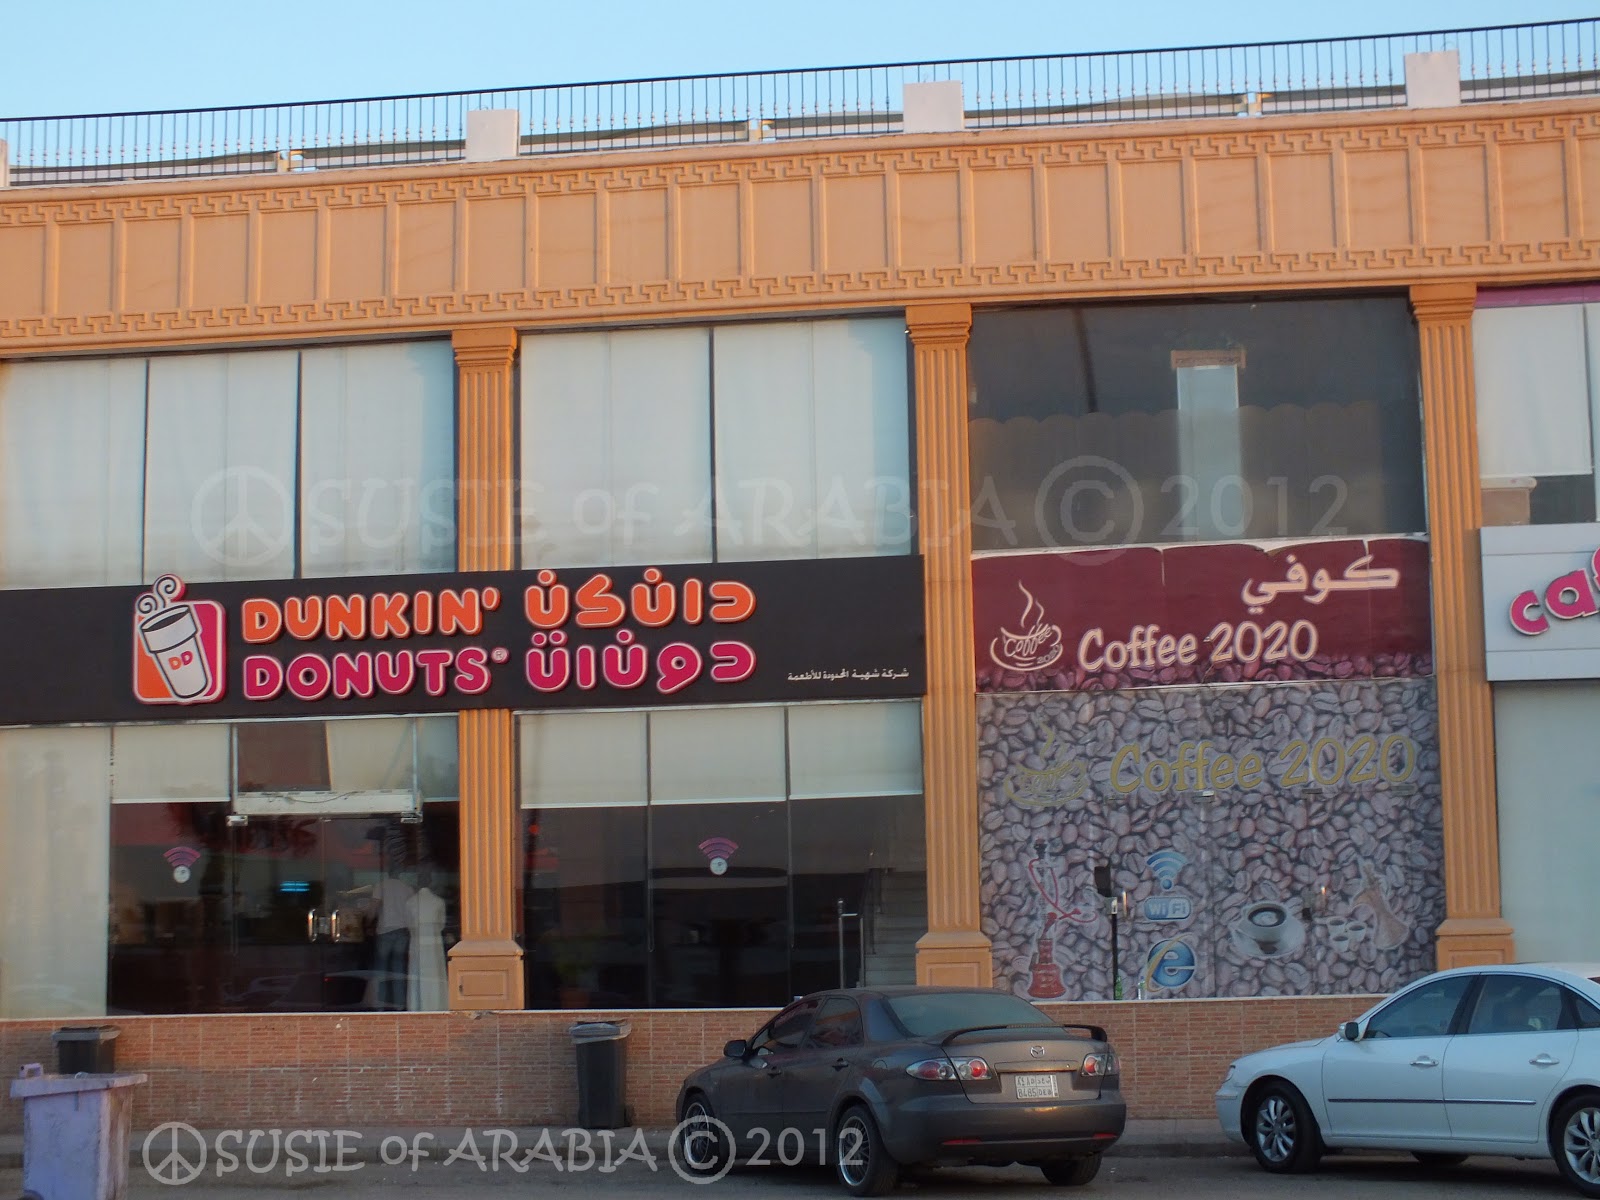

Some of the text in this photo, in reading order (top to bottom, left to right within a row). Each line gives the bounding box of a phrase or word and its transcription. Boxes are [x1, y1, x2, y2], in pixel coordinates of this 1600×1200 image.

[524, 567, 757, 629] دانكن
[1241, 554, 1400, 614] كوفي
[168, 650, 194, 671] DD
[524, 629, 757, 695] دونات
[881, 667, 910, 680] شركة
[1078, 619, 1318, 672] Coffee 2020
[1109, 741, 1264, 794] Coffee
[1279, 734, 1415, 788] 2020
